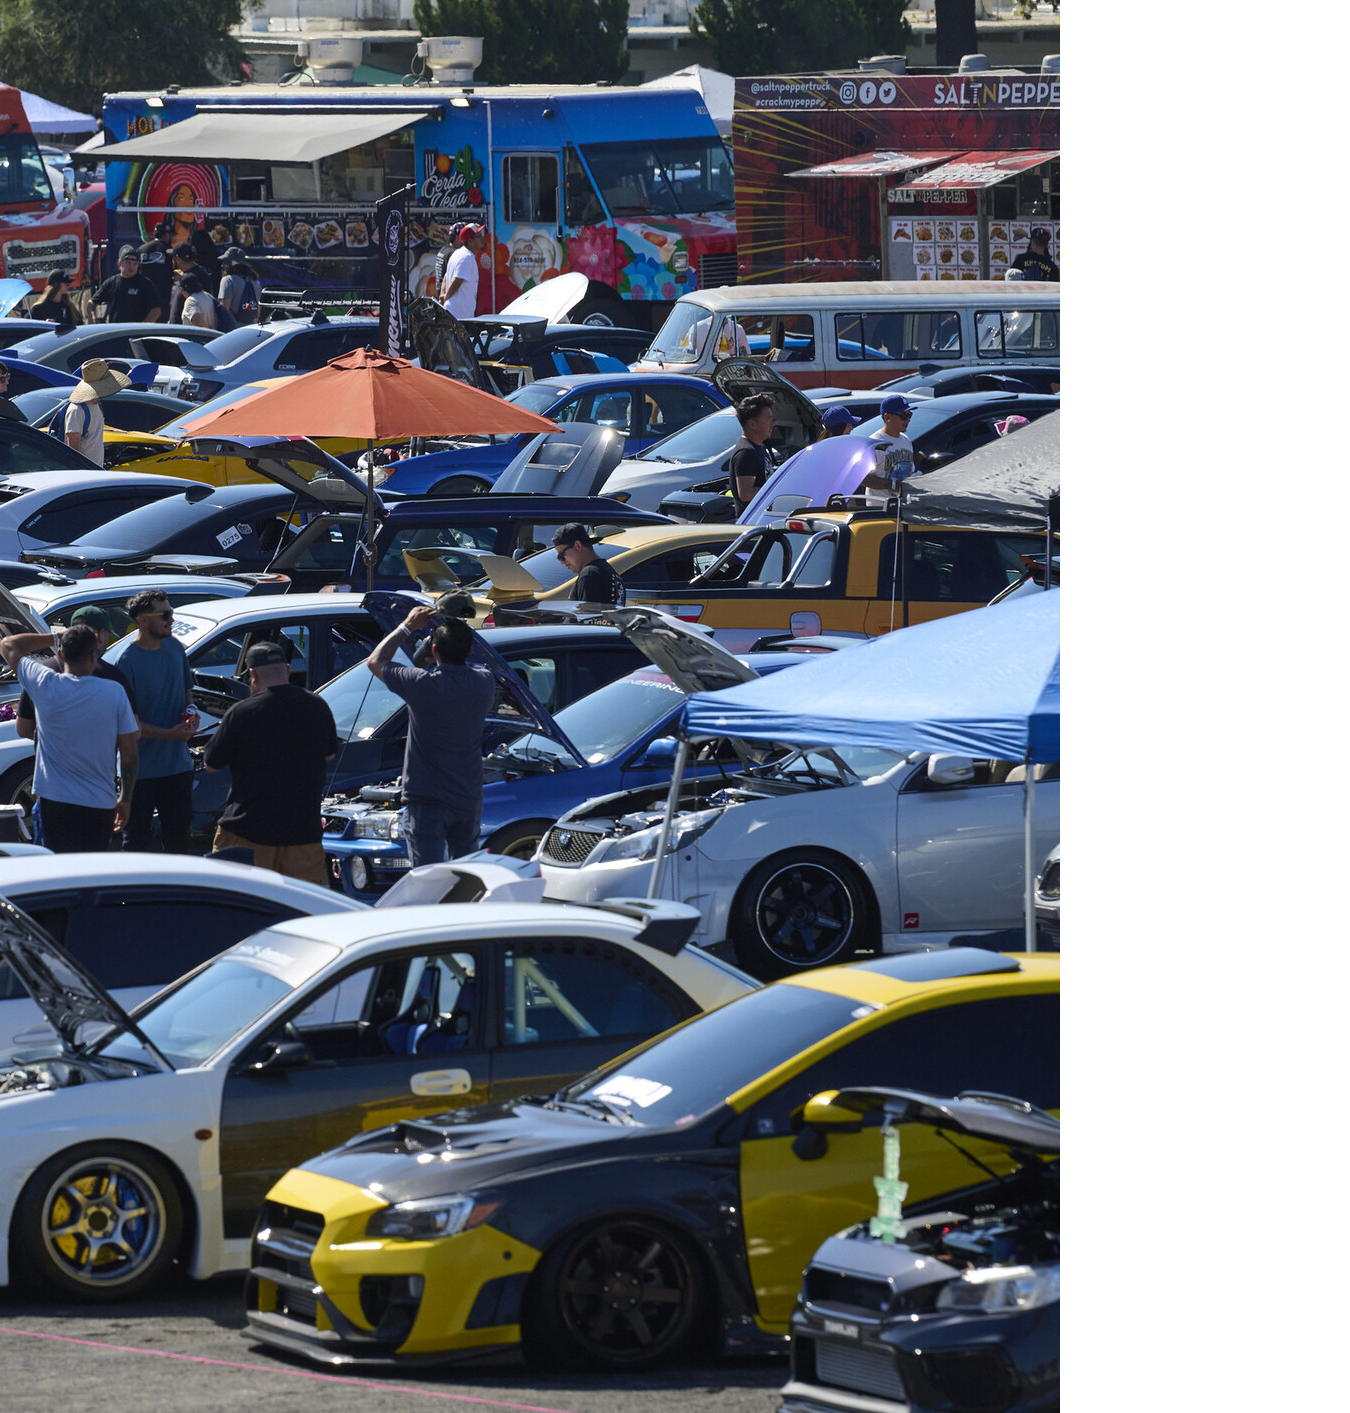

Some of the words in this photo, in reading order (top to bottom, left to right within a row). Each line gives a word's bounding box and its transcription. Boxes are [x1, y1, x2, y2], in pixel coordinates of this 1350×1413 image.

[751, 80, 831, 94] @saltnpeppertruck
[755, 96, 824, 108] #crackmypeppe
[421, 171, 467, 199] Cerda
[222, 532, 240, 547] 0275
